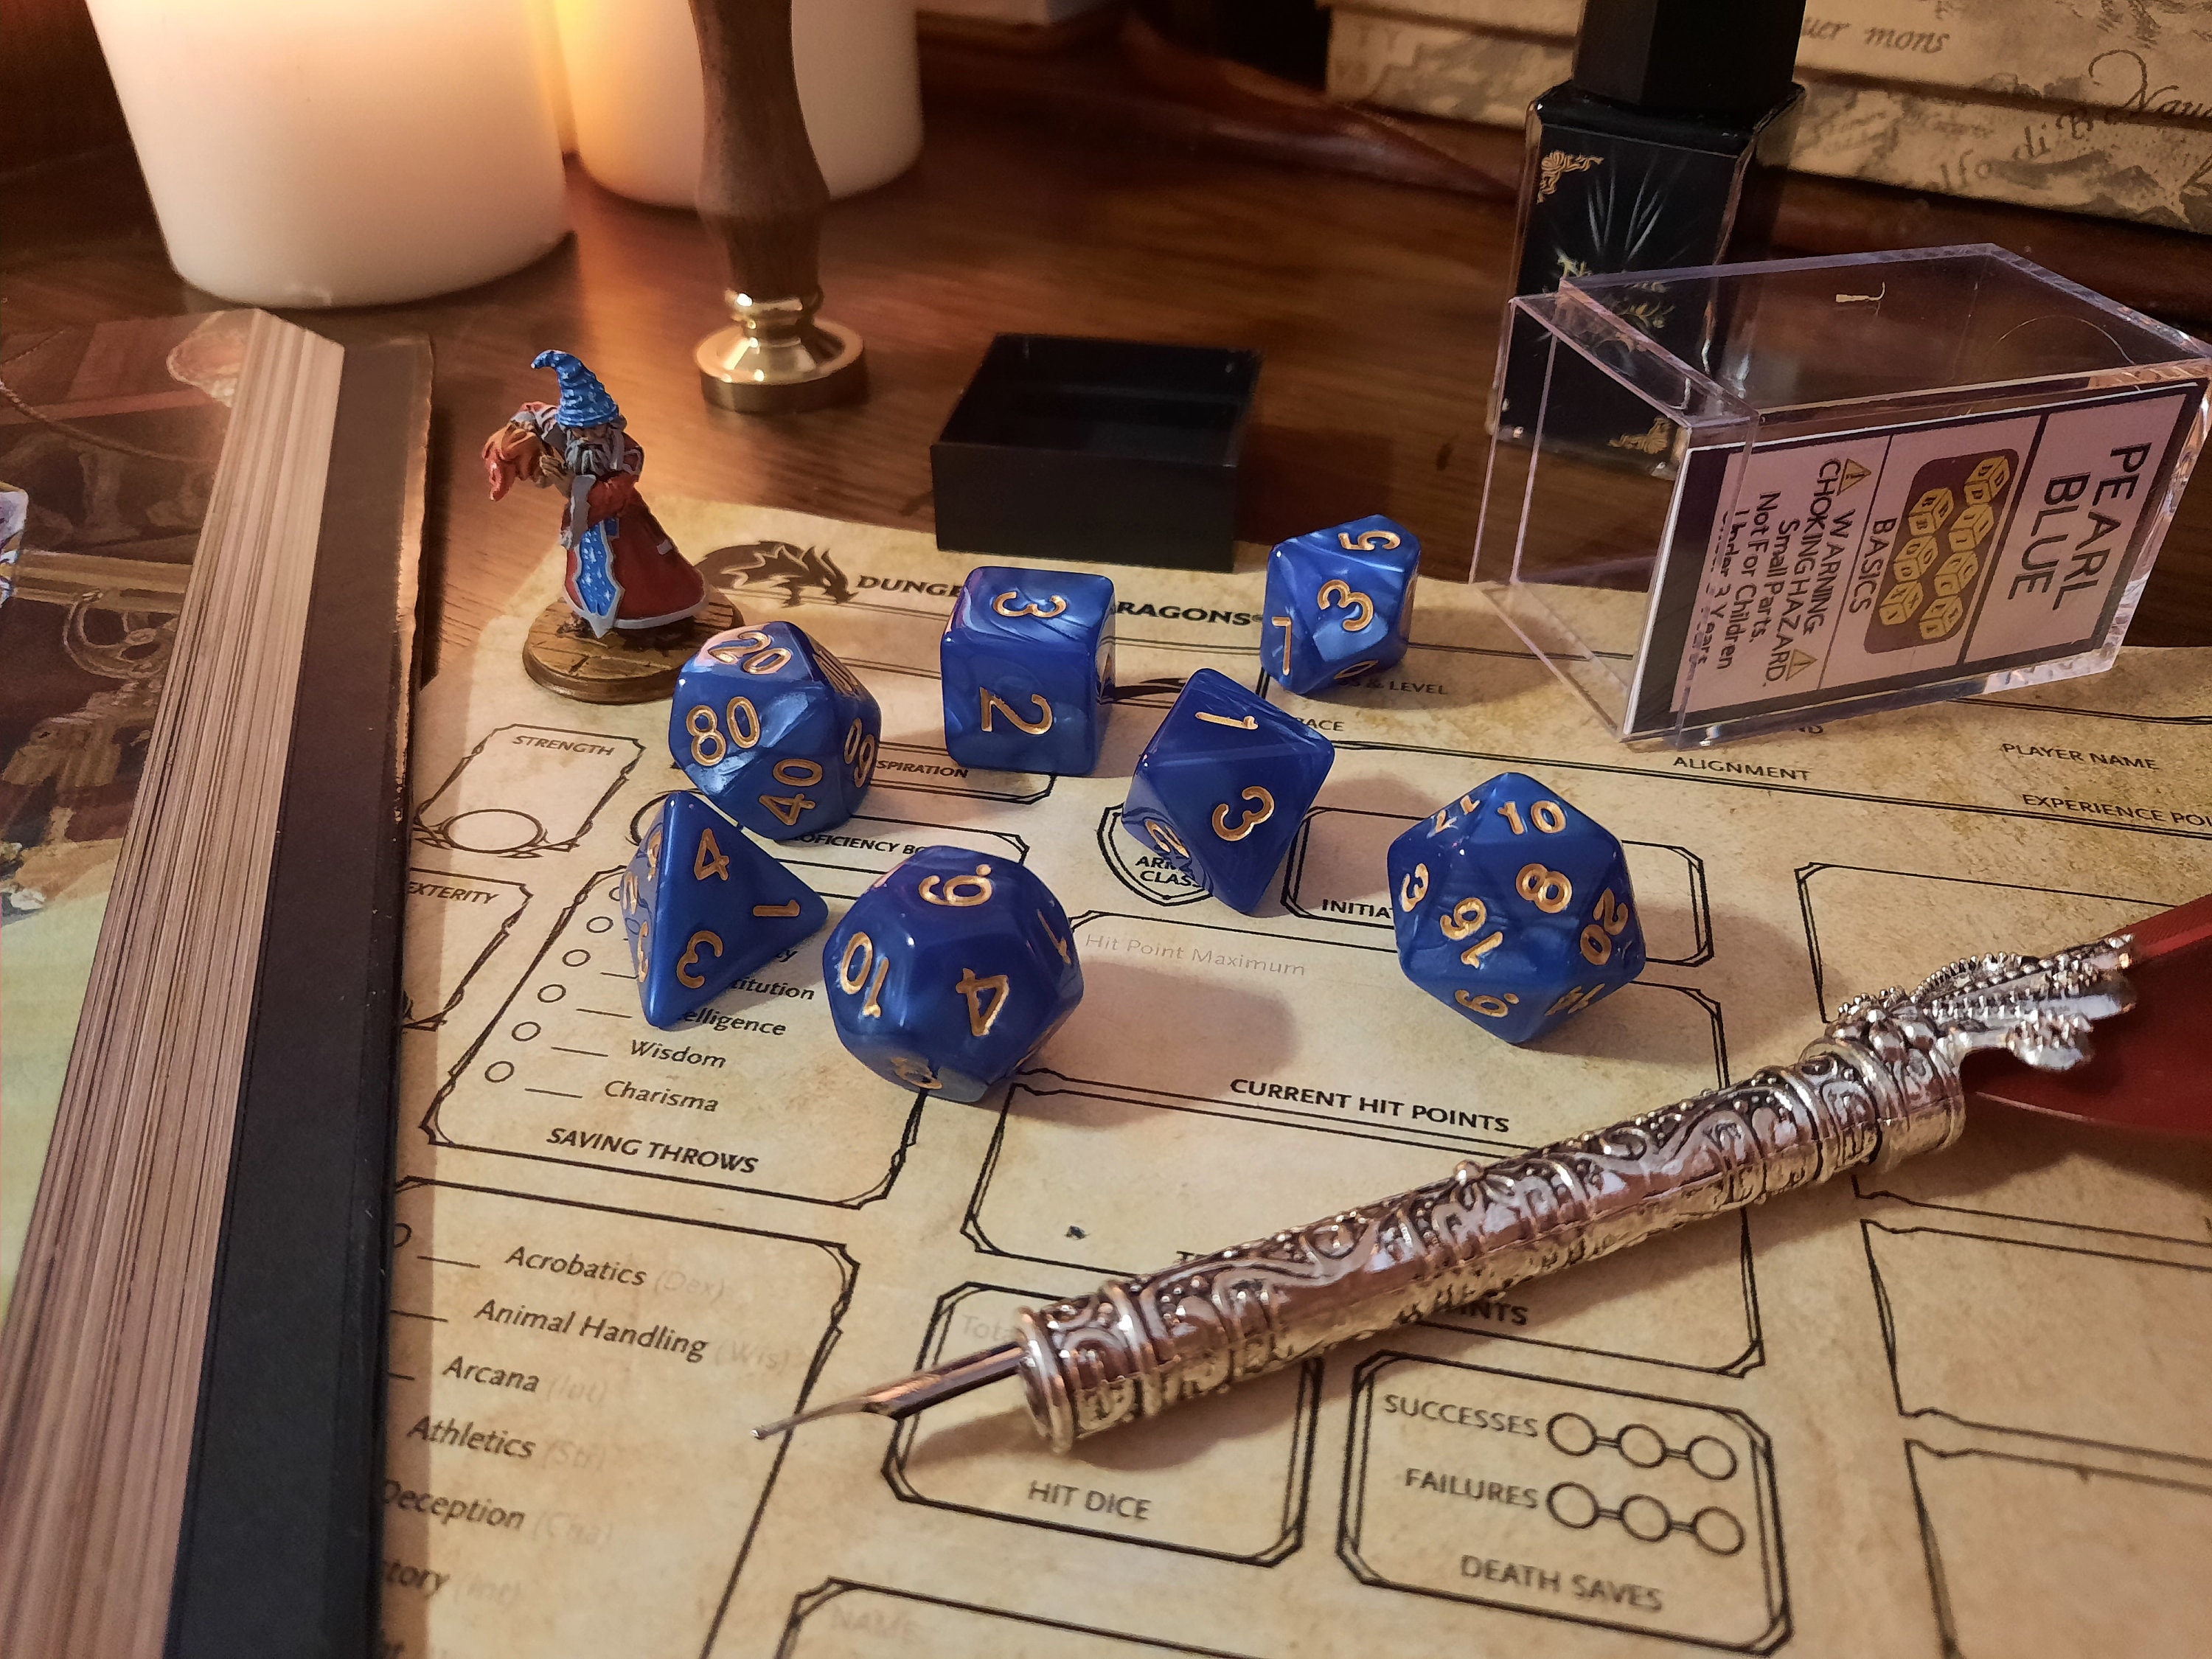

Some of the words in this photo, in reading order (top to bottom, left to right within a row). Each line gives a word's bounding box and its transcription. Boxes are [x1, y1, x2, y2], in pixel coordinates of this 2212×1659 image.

[1750, 490, 1781, 538] Not
[1793, 458, 1842, 575] CHOKING
[2007, 473, 2091, 599] BLUE
[2051, 442, 2152, 611] PEARL
[1740, 540, 1769, 577] For
[1766, 518, 1801, 578] Small
[1803, 509, 1856, 636] WARNING
[1848, 517, 1898, 614] BASICS
[992, 591, 1068, 619] 3
[1317, 579, 1374, 632] 3
[1717, 584, 1758, 670] Children
[708, 630, 792, 675] 20
[978, 686, 1054, 736] 2
[1389, 680, 1449, 695] LEVEL
[512, 734, 616, 757] STRENGTH
[684, 695, 761, 767] 80
[1672, 755, 1810, 782] ALIGNMENT
[2000, 742, 2084, 762] PLAYER
[2089, 752, 2160, 771] NAME
[759, 758, 823, 827] 40
[1211, 785, 1276, 842] 3
[2023, 793, 2166, 822] EXPERIENCE
[1497, 800, 1568, 835] 10
[693, 827, 731, 883] 4
[1139, 870, 1203, 888] CLAS
[752, 900, 801, 918] 1
[1322, 898, 1393, 919] INITIA
[1401, 863, 1430, 913] 3
[1515, 863, 1573, 914] 8
[1579, 887, 1629, 966] 20
[675, 930, 724, 990] 3
[1084, 933, 1120, 953] Hit
[1127, 938, 1185, 961] Point
[1192, 947, 1306, 976] Maximum
[956, 967, 1009, 1037] 4
[631, 1038, 727, 1070] Wisdom
[604, 1079, 719, 1113] Charisma
[1230, 1077, 1352, 1111] CURRENT
[1358, 1093, 1405, 1116] HIT
[1411, 1103, 1511, 1133] POINTS
[546, 1126, 642, 1158] SAVING
[646, 1140, 759, 1175] THROWS
[504, 1245, 647, 1287] Acrobatics
[473, 1298, 574, 1335] Animal
[578, 1314, 709, 1364] Handling
[442, 1354, 540, 1394] Arcana
[406, 1413, 536, 1461] Athletics
[1382, 1394, 1540, 1439] SUCCESSES
[383, 1478, 526, 1532] Deception
[1027, 1479, 1079, 1509] HIT
[1085, 1490, 1154, 1523] DICE
[1403, 1467, 1540, 1509] FAILURES
[1460, 1554, 1561, 1592] DEATH
[1571, 1573, 1663, 1612] SAVES
